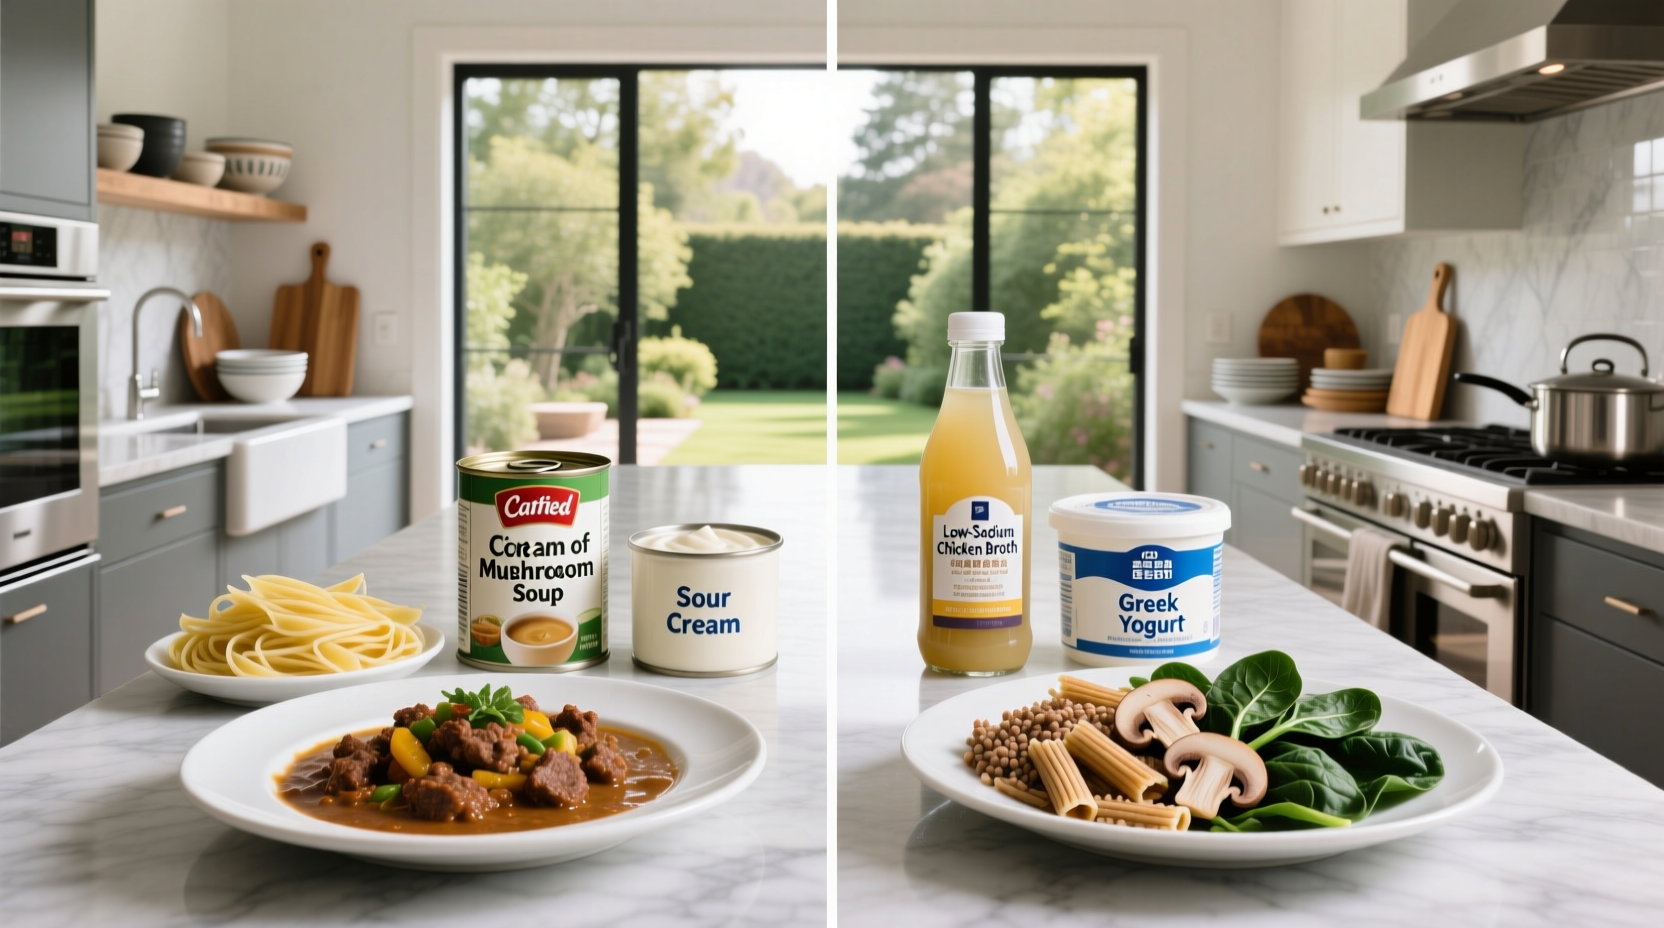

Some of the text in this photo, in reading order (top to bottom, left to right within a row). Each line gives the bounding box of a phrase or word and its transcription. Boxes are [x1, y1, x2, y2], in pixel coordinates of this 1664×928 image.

[570, 532, 590, 554] of
[937, 540, 1018, 555] Chicken Broth
[513, 583, 564, 606] Soup
[676, 585, 731, 608] Sour
[1118, 592, 1179, 613] Greek
[666, 612, 740, 635] Cream
[1118, 615, 1186, 639] Yogurt
